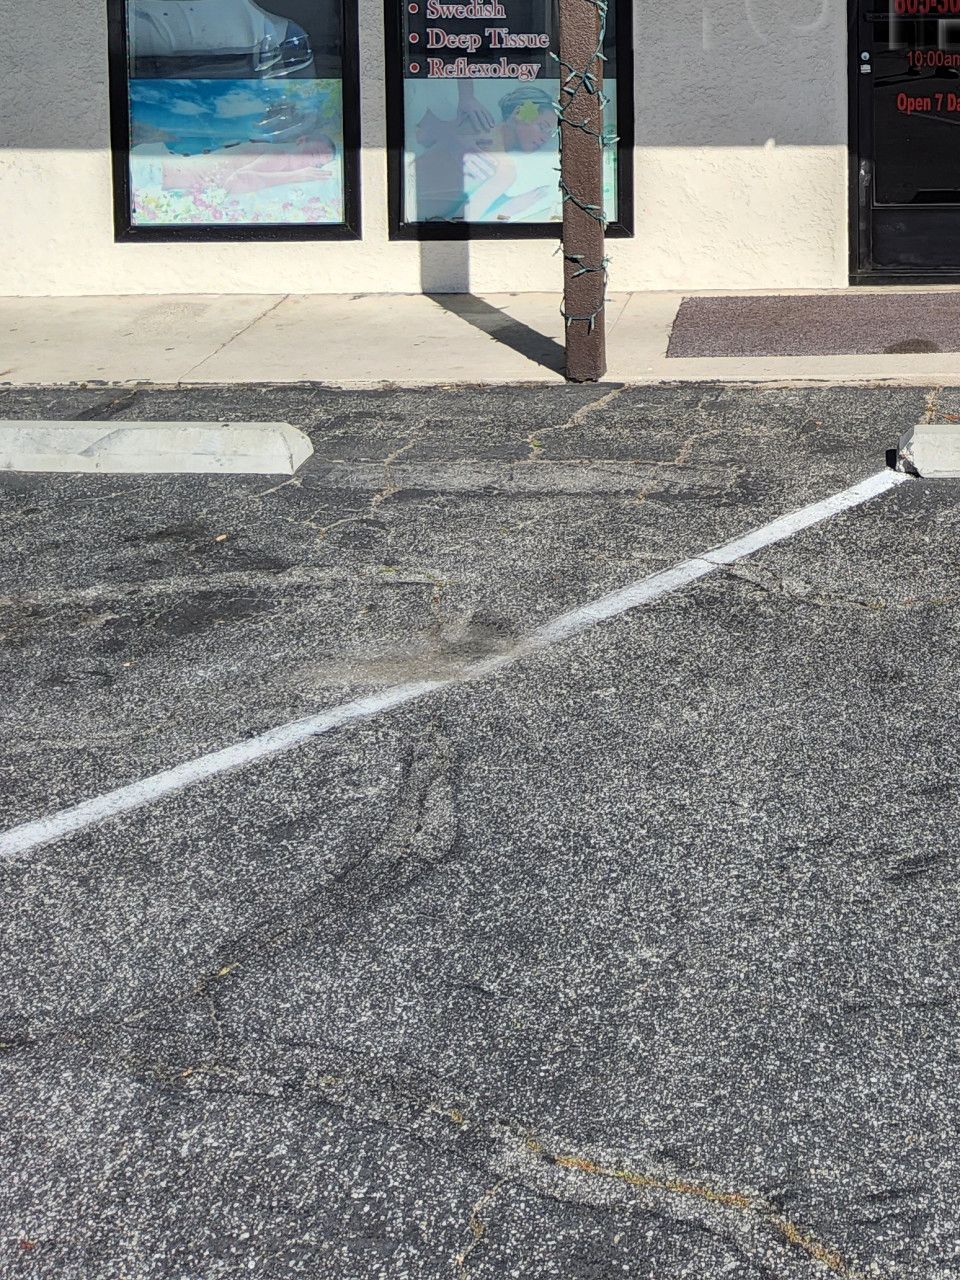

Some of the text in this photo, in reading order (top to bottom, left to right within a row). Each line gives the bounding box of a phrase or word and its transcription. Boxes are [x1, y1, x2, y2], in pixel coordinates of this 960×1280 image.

[427, 28, 550, 52] Deep Tissue
[427, 57, 541, 81] Reflexology
[897, 93, 931, 114] Open
[934, 93, 942, 111] 7
